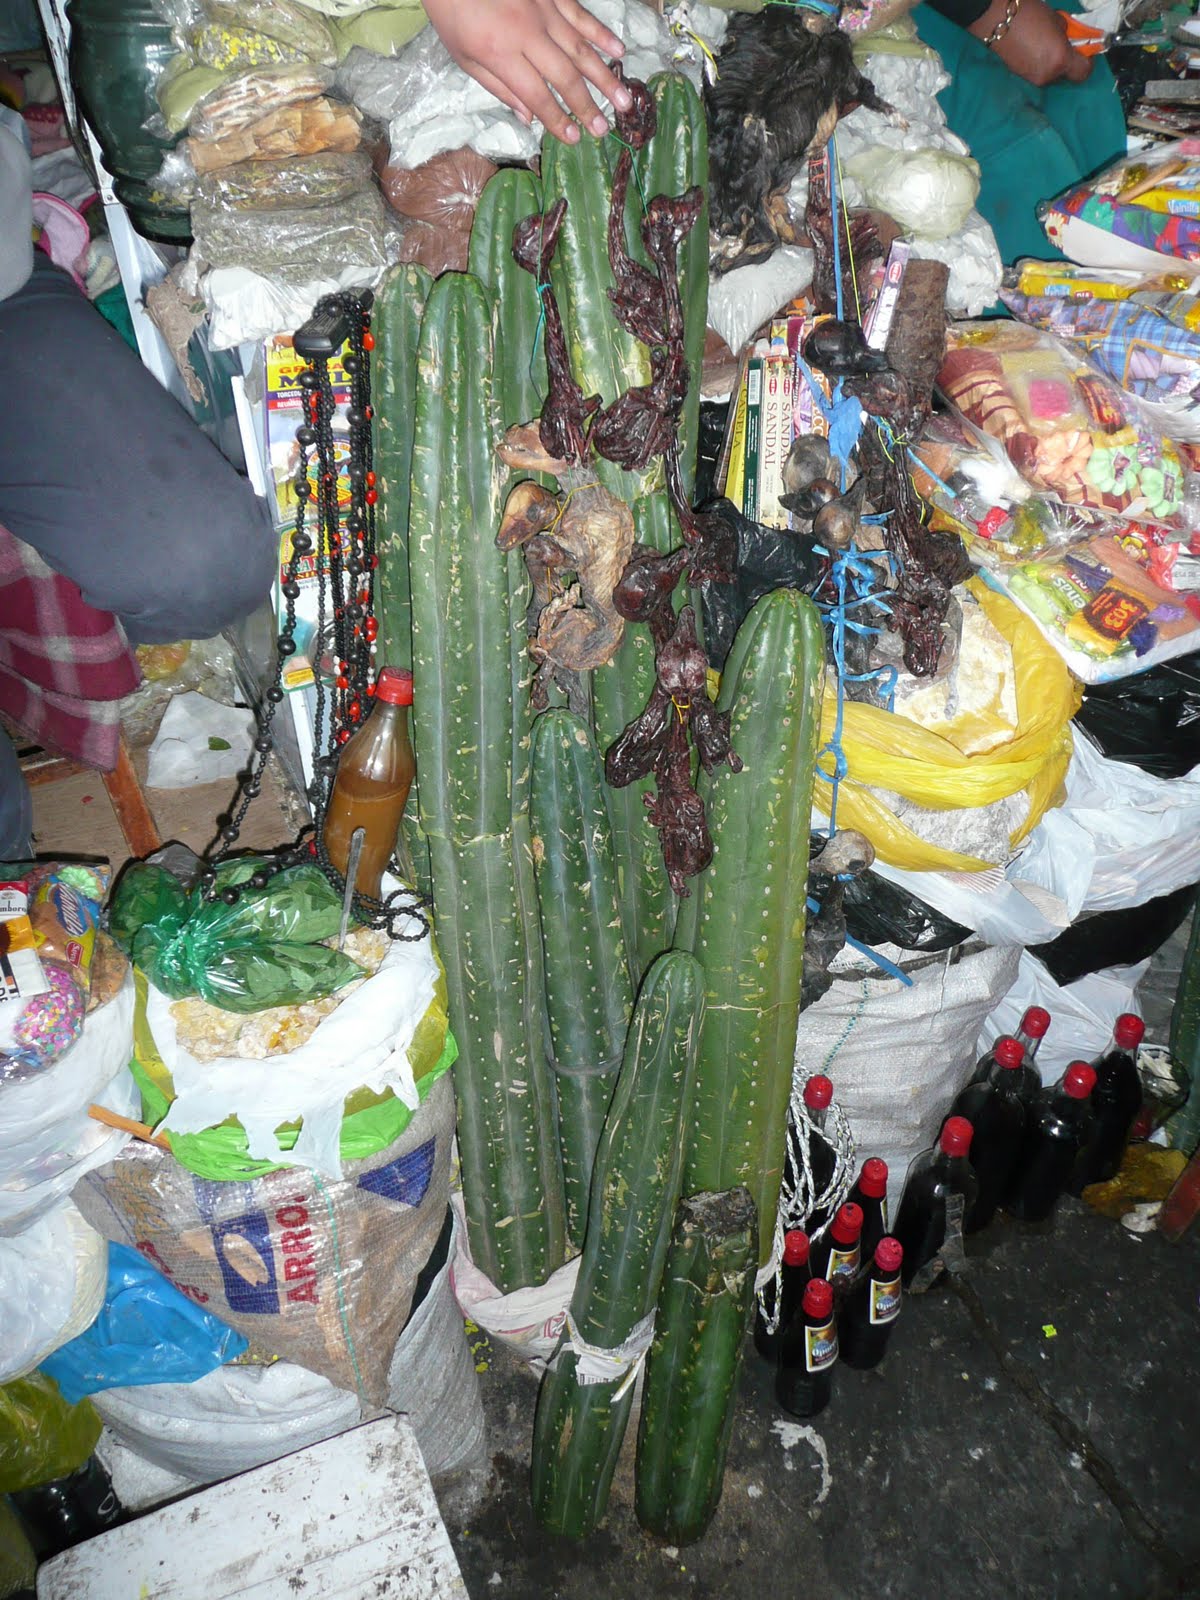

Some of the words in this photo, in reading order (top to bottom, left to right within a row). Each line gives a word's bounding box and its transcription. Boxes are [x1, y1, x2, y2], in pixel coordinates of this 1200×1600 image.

[769, 377, 777, 396] HEM
[783, 376, 791, 396] HEM
[732, 388, 749, 449] CANELA
[764, 401, 778, 470] SANDAL
[1052, 576, 1087, 609] ends
[272, 1194, 320, 1304] ARRO
